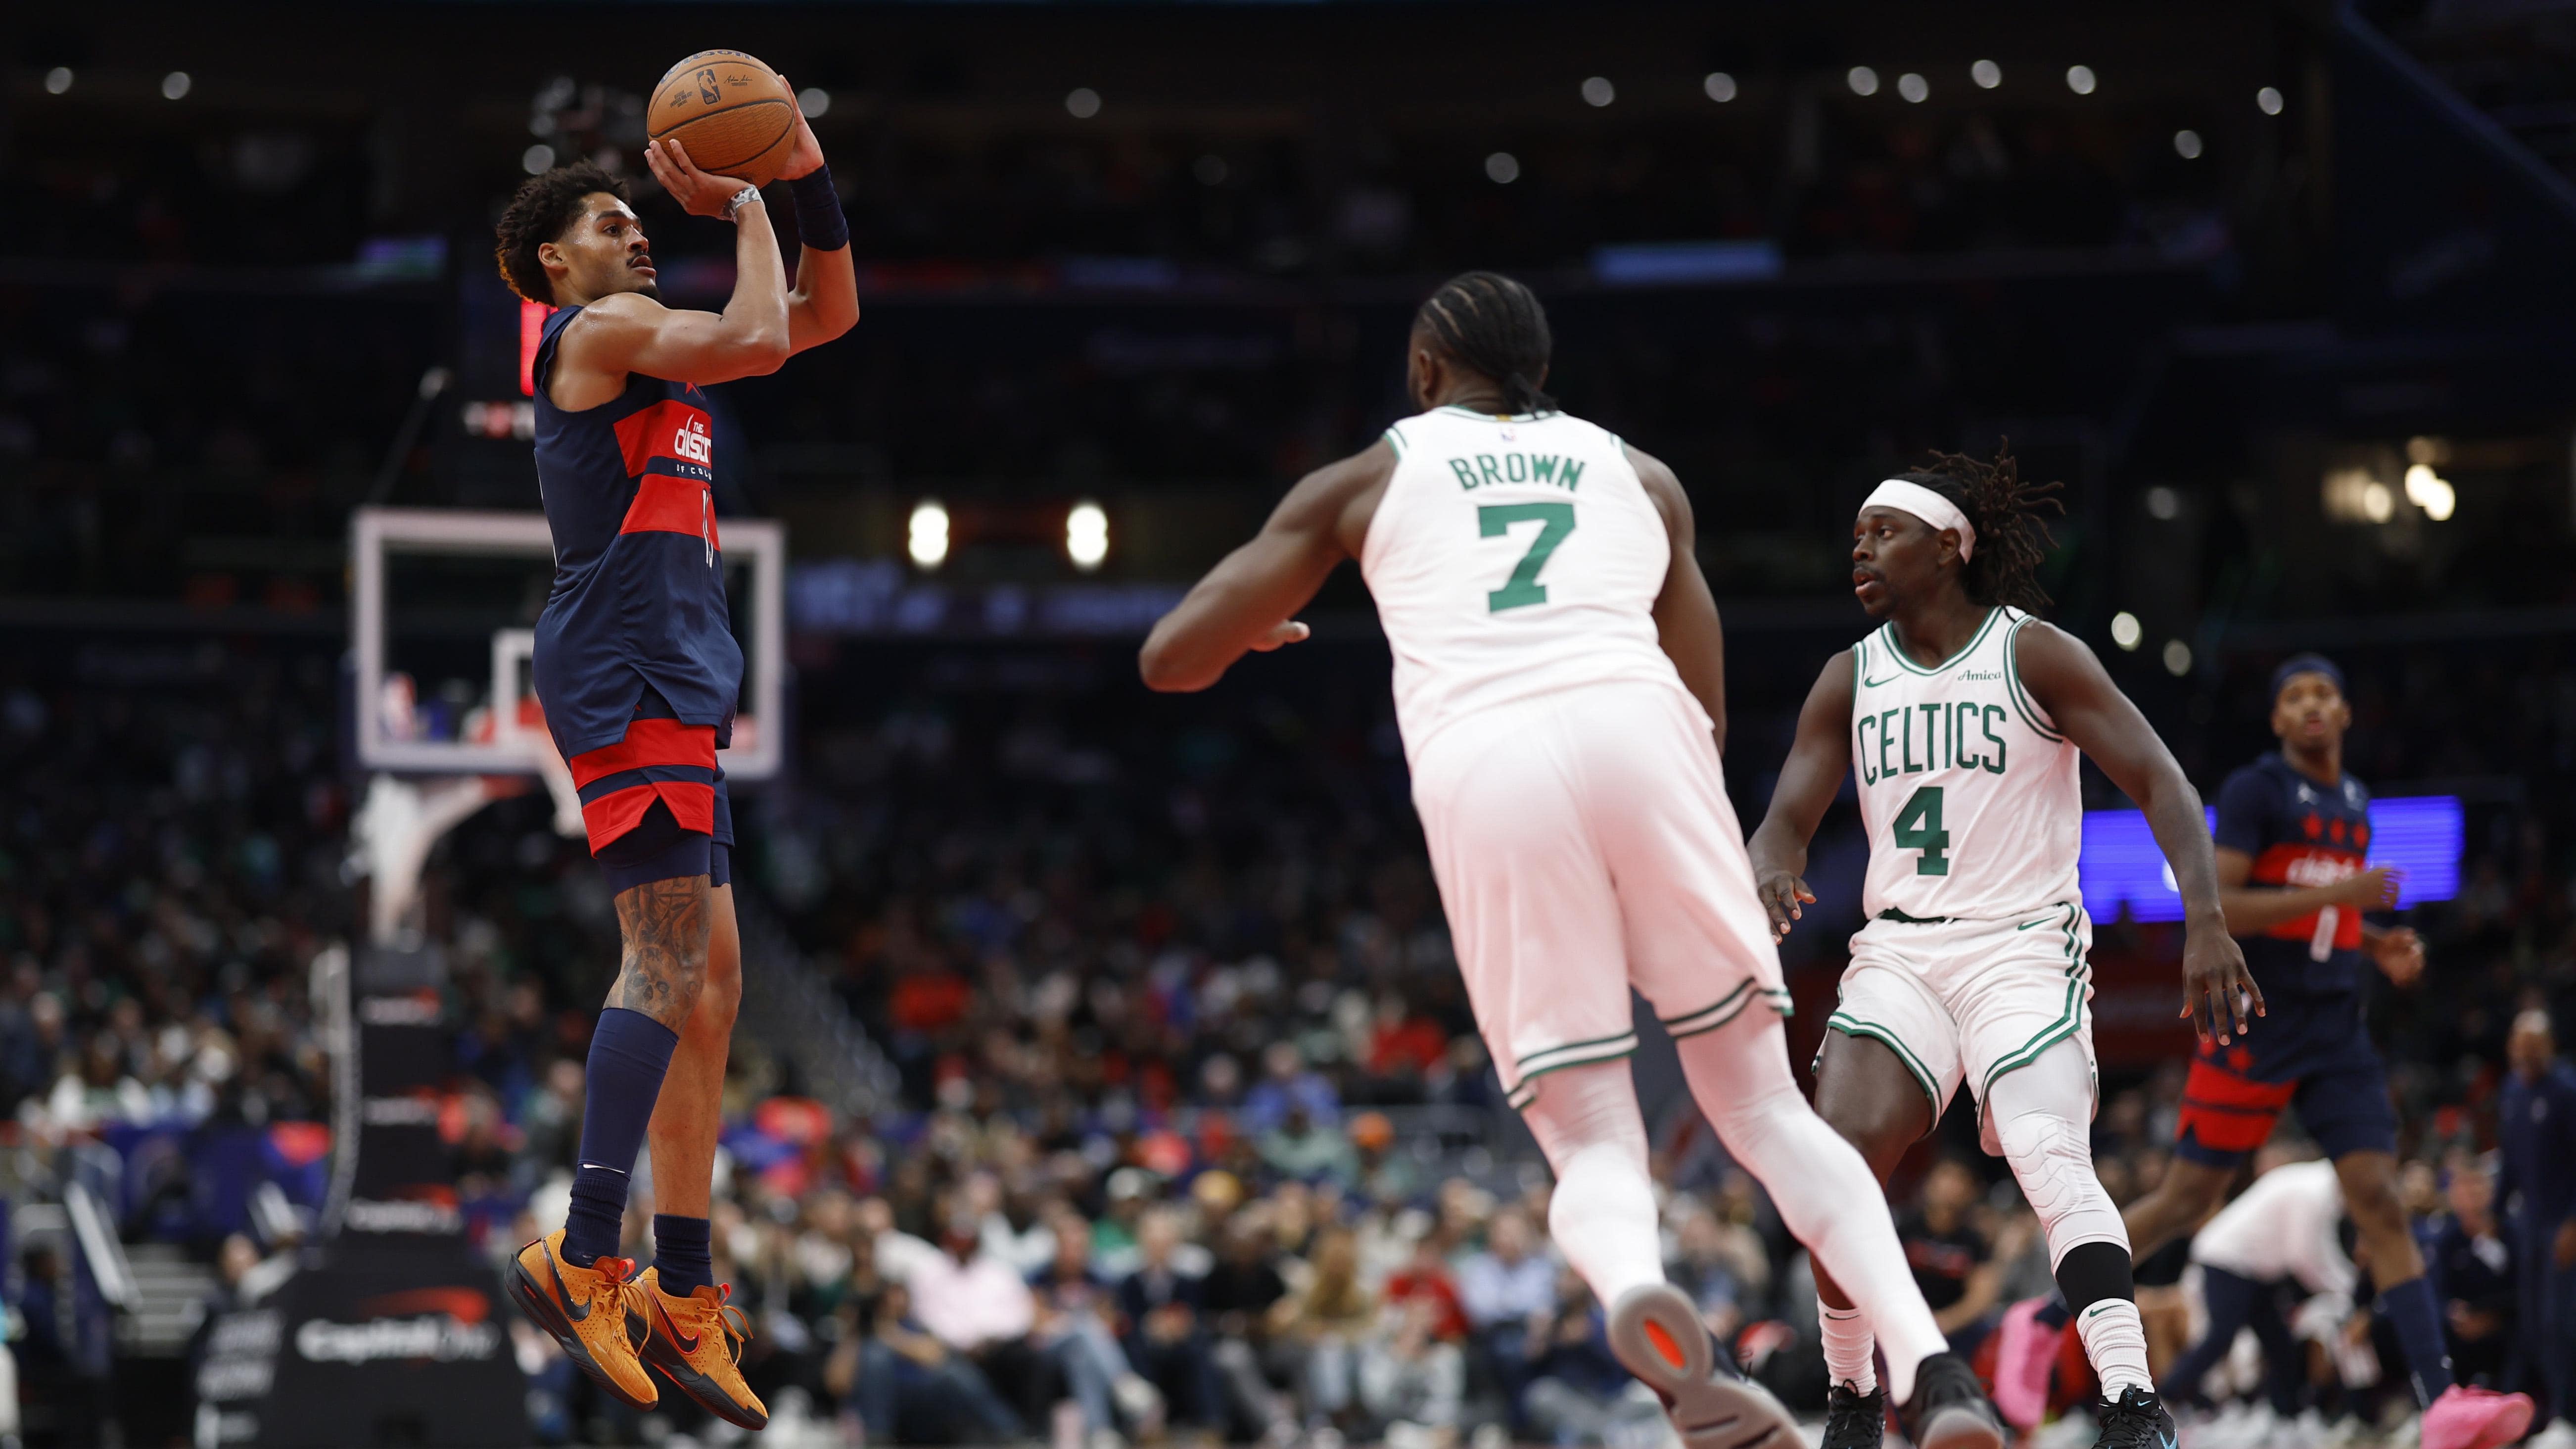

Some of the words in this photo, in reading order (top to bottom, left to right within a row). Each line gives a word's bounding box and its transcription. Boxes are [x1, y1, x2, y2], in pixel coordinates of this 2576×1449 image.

[693, 422, 703, 434] THE
[677, 464, 685, 473] OF
[1448, 453, 1586, 492] BROWN
[1477, 502, 1576, 614] 7
[1958, 669, 2002, 682] Amica
[1858, 702, 2007, 786] CELTICS
[1893, 786, 1949, 876] 4
